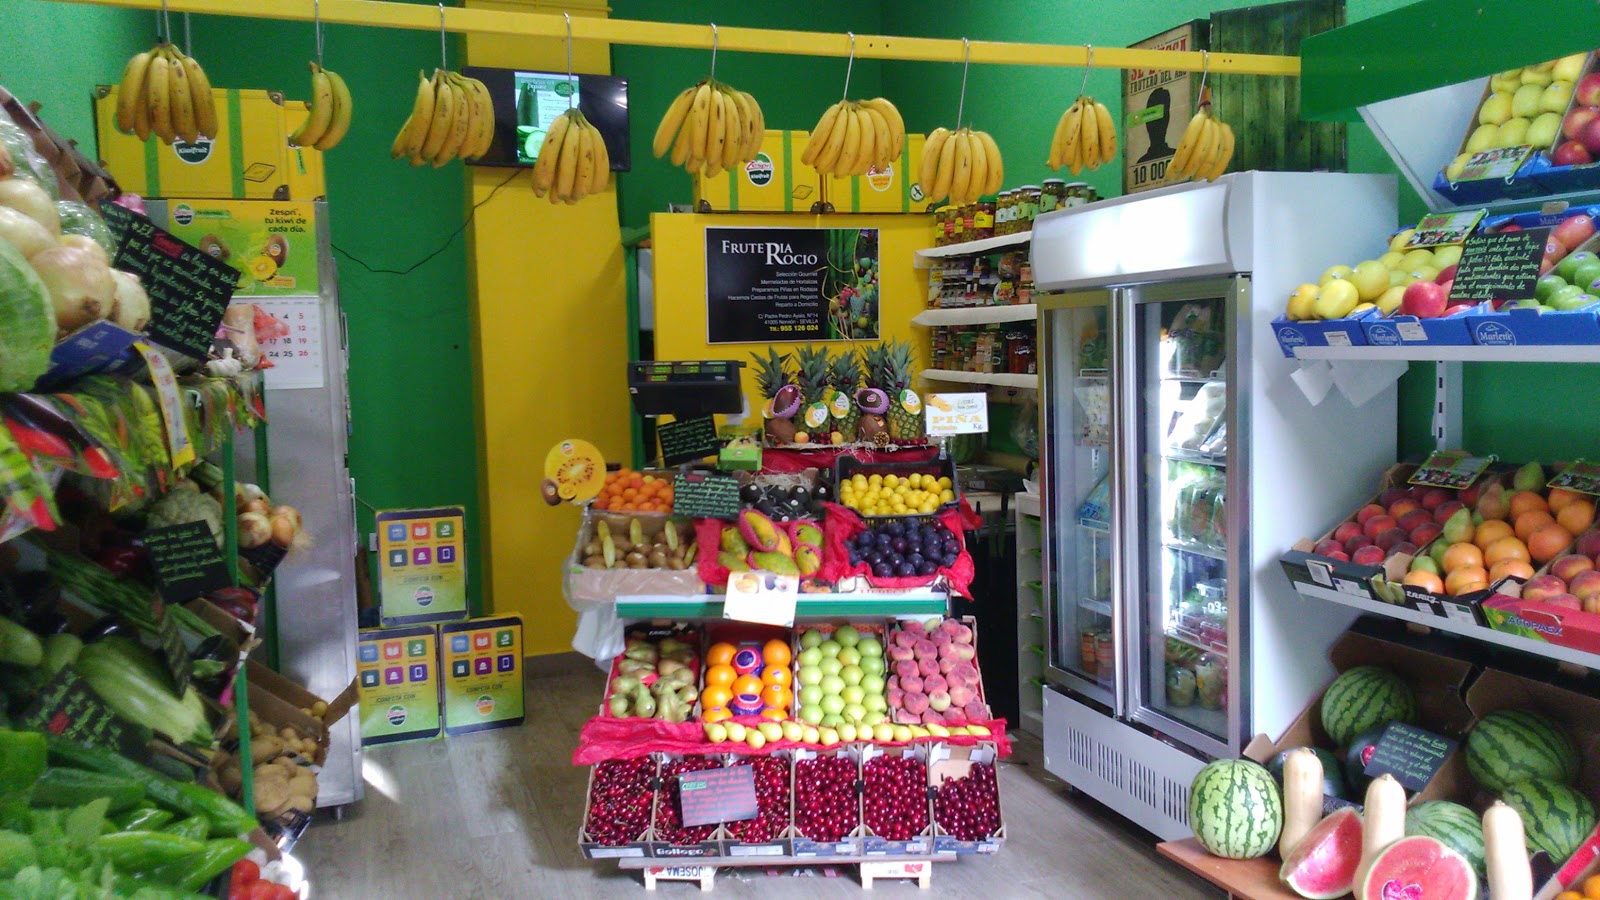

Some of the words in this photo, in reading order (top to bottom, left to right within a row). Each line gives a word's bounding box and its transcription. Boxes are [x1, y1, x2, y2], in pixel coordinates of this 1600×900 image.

[1160, 70, 1172, 84] DEL
[1134, 166, 1146, 184] 10
[666, 866, 704, 878] JOSEMA
